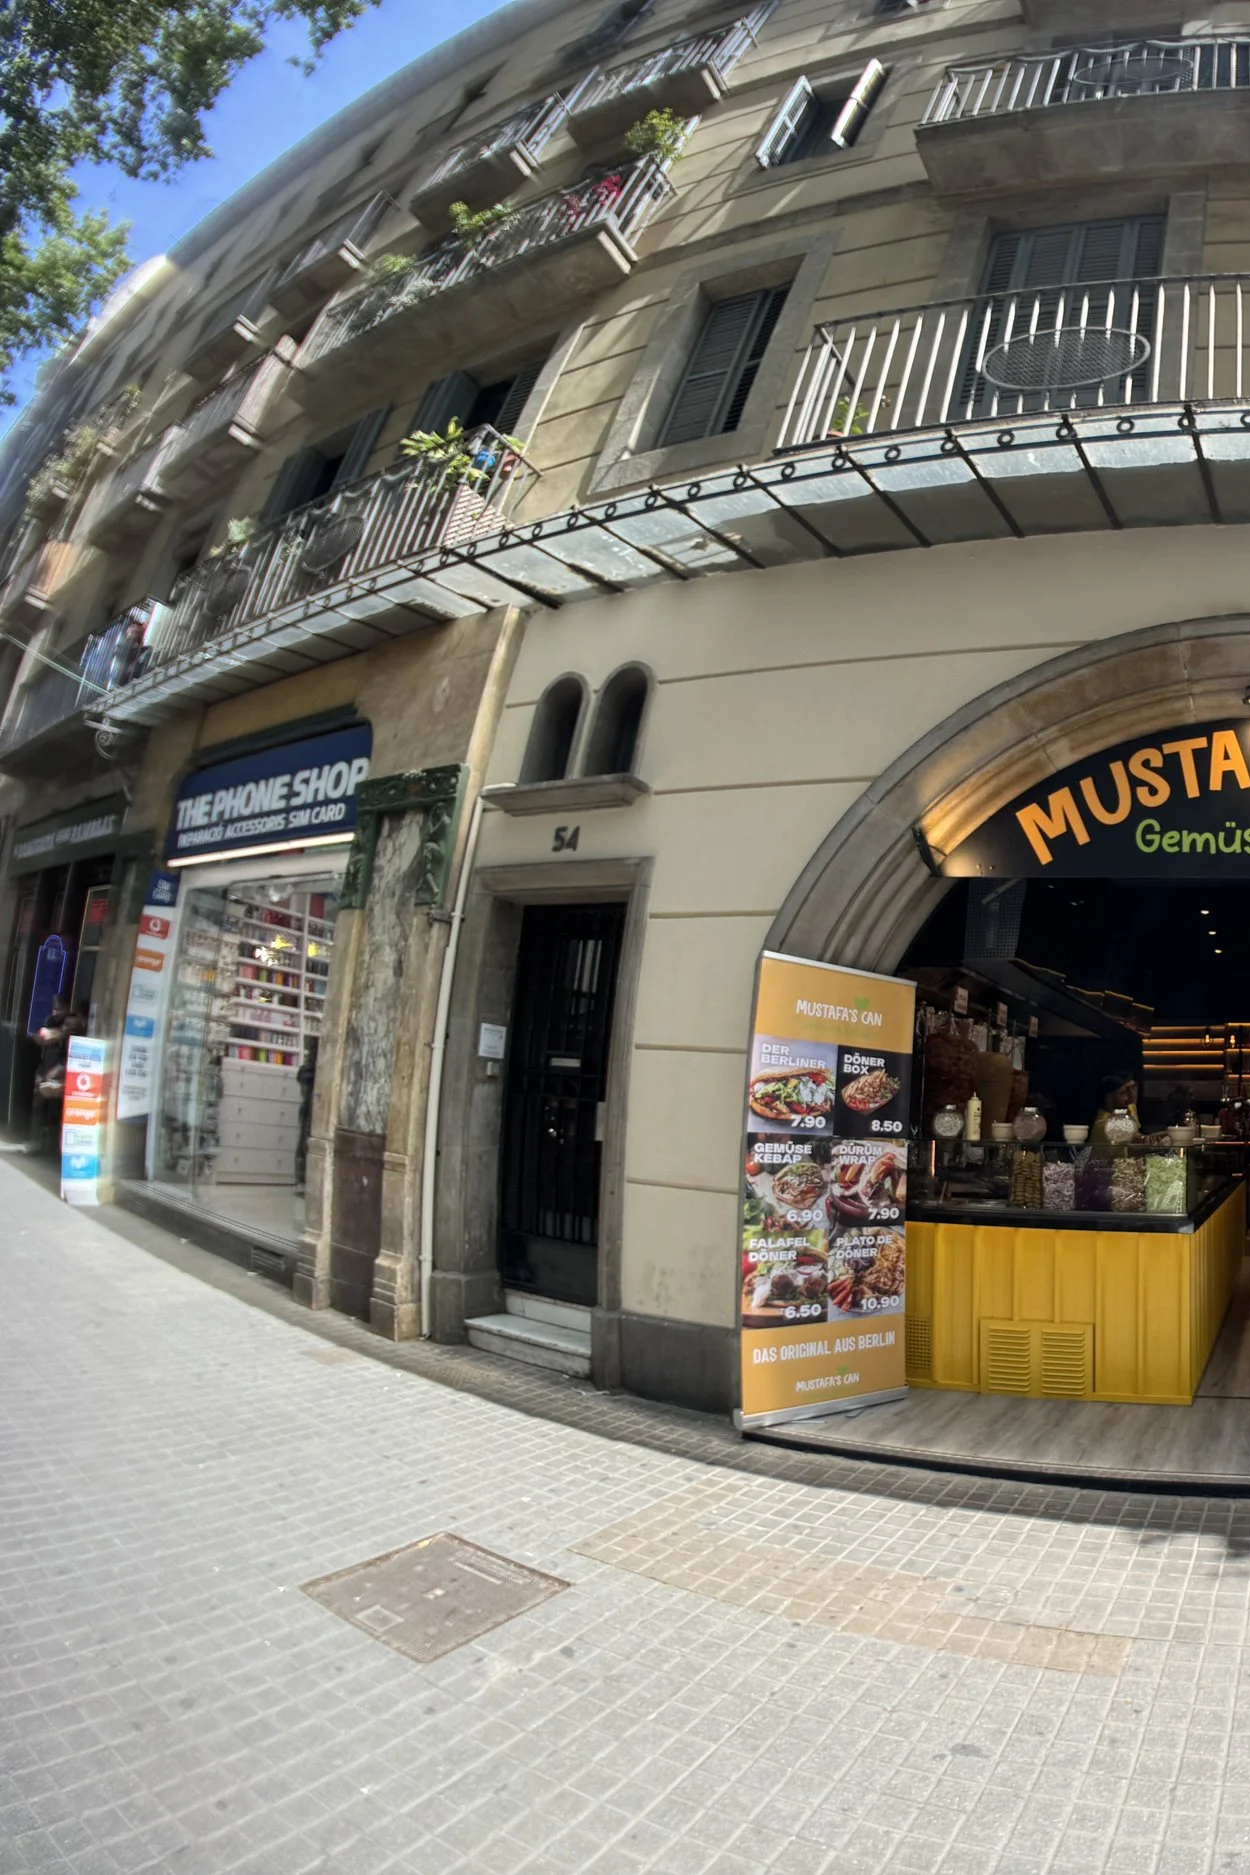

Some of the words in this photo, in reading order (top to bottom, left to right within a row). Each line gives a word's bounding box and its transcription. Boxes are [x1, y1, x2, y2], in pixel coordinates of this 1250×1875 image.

[176, 792, 214, 831] THE
[212, 774, 291, 822] PHONE
[290, 757, 370, 807] SHOP
[224, 813, 286, 840] ACCESSORIS
[288, 809, 311, 829] SIM
[311, 802, 346, 825] CARD
[552, 825, 580, 852] 54
[796, 999, 858, 1024] MUSTAFA'S
[861, 1010, 883, 1026] CAN
[762, 1043, 790, 1055] DER
[761, 1054, 827, 1069] BERLINER
[844, 1053, 886, 1067] DÖNER
[843, 1065, 870, 1075] BOX
[790, 1115, 827, 1129] 7.90
[871, 1120, 903, 1132] 8.50
[754, 1141, 813, 1155] GEMÜSE
[839, 1143, 882, 1155] DÜRÜM
[754, 1153, 802, 1164] KEBAP
[839, 1155, 877, 1165] WRAP
[786, 1209, 824, 1222] 6.90
[868, 1207, 900, 1220] 7.90
[750, 1236, 811, 1249] FALAFEL
[836, 1236, 875, 1247] PLATO
[876, 1235, 893, 1245] DE
[749, 1249, 797, 1262] DÖNER
[836, 1247, 879, 1259] DÖNER
[860, 1295, 900, 1312] 10.90
[784, 1303, 822, 1319] 6.50
[753, 1346, 777, 1364] DAS
[780, 1340, 832, 1361] ORIGINAL
[834, 1336, 856, 1353] AUS
[858, 1331, 896, 1349] BERLIN
[795, 1374, 842, 1392] MUSTAFA'S
[843, 1372, 860, 1384] CAN
